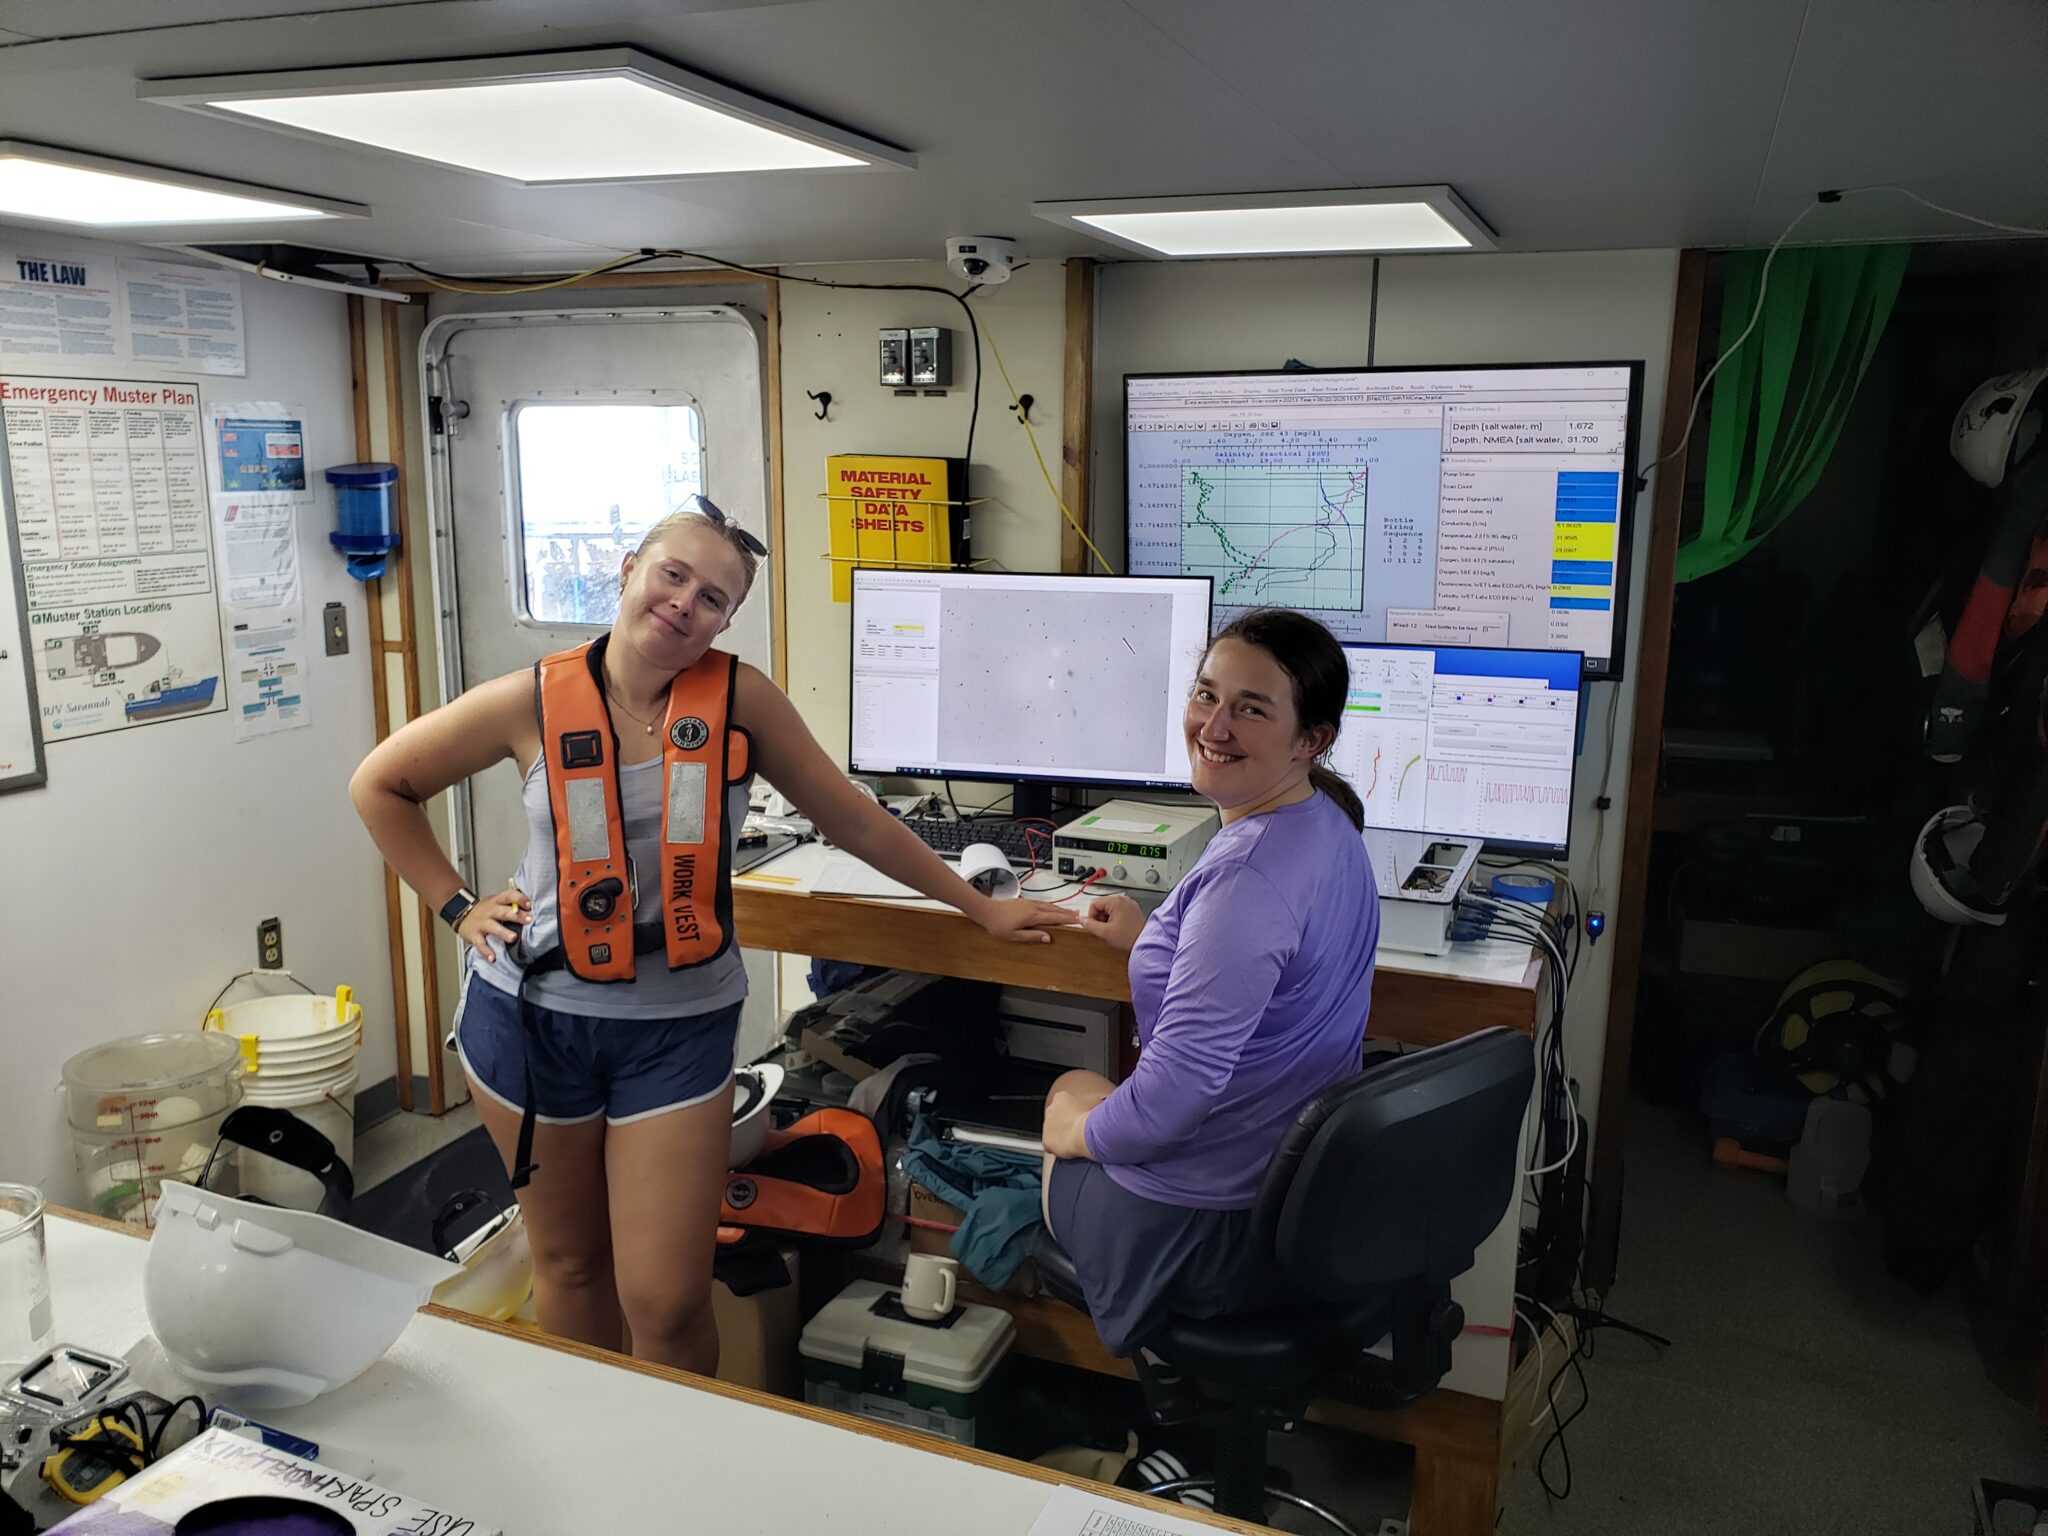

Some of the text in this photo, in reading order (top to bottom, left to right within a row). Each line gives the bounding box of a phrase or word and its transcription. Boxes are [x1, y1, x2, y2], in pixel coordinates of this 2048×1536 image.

[17, 260, 49, 282] THE
[51, 264, 86, 286] LAW
[0, 382, 195, 405] Emergency Muster Plan
[1453, 422, 1543, 432] Depth [salt water, m]
[1569, 422, 1594, 430] 1.672
[1452, 436, 1563, 445] Depth, NMEA [salt water,
[1567, 436, 1598, 444] 31.700
[840, 470, 932, 486] MATERIAL
[850, 486, 922, 501] SAFETY
[864, 502, 909, 517] DATA
[851, 518, 925, 533] SHEETS
[25, 558, 142, 573] Emergency Station Assignments
[42, 601, 172, 624] Muster Station Locations
[43, 696, 111, 717] R/V Savannah
[673, 853, 696, 901] WORK
[673, 904, 701, 942] VEST
